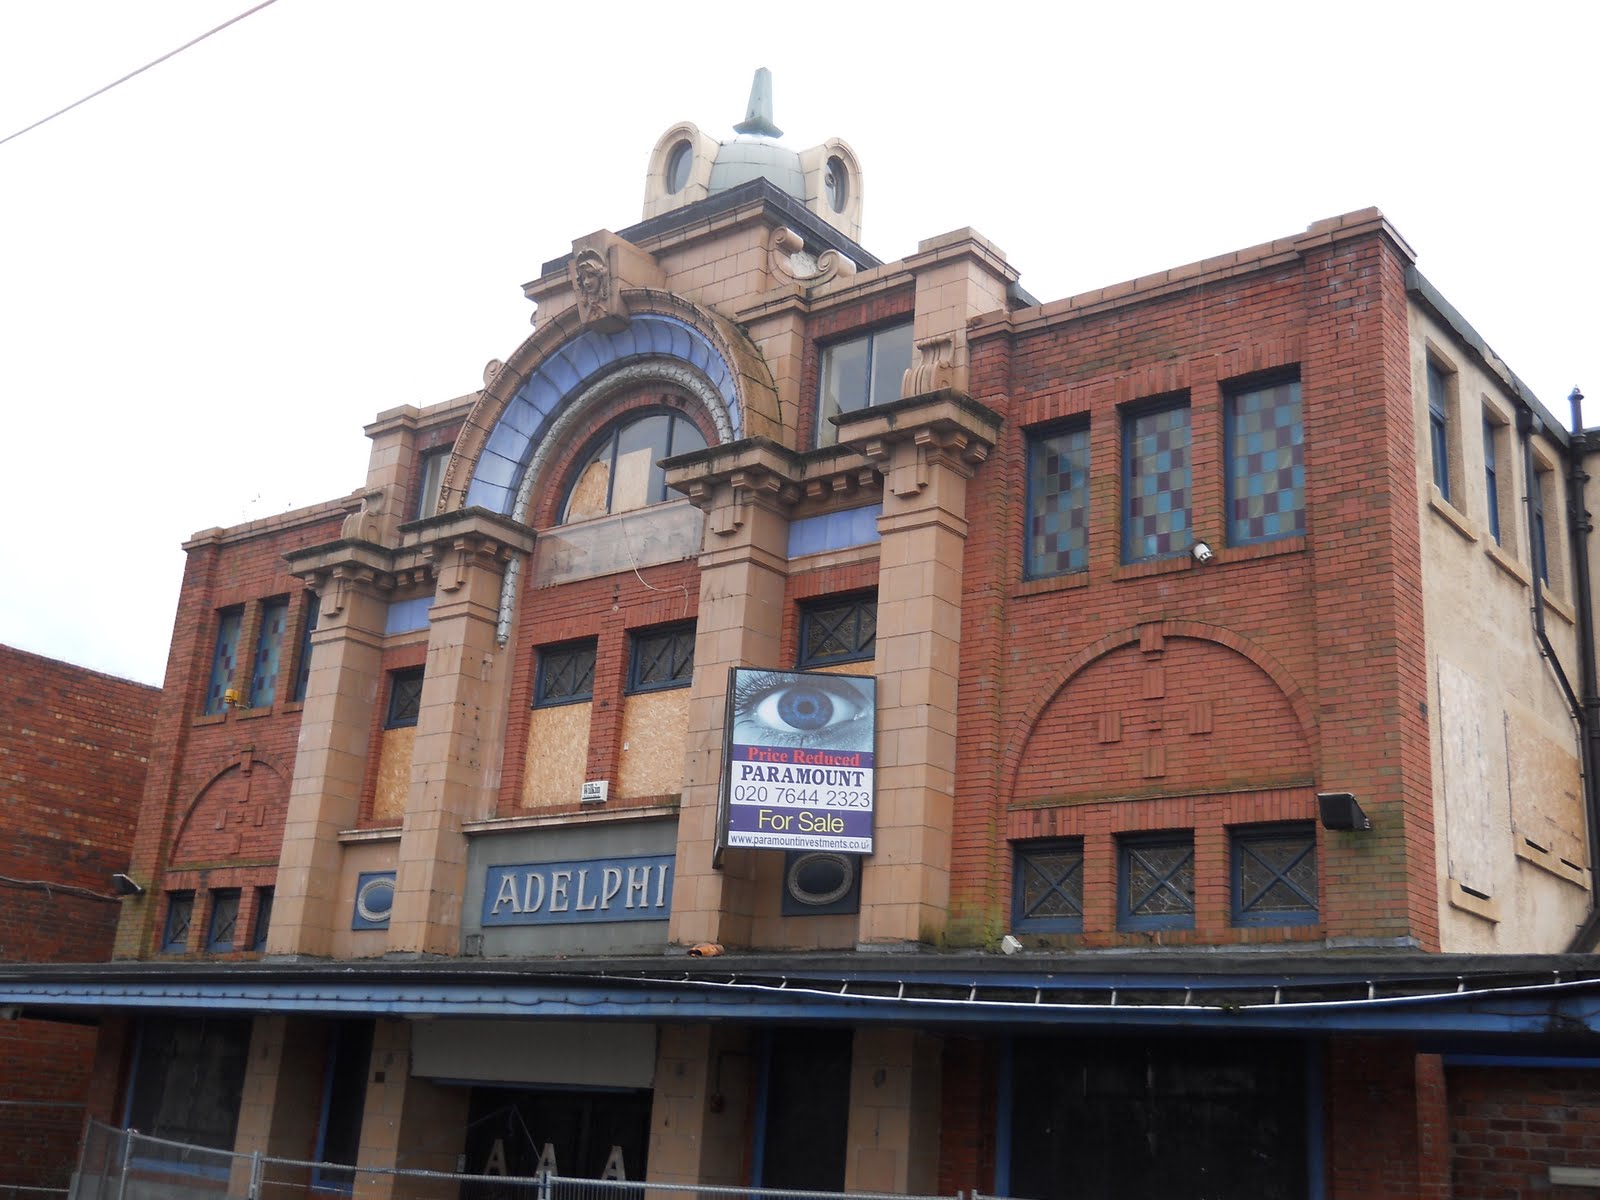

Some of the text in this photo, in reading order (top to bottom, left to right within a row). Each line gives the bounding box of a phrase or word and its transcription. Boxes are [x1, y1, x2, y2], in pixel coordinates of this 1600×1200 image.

[747, 747, 861, 767] Price Reduced
[741, 765, 865, 787] PARAMOUNT
[734, 785, 870, 808] 020 7644 2323
[758, 809, 844, 833] For Sale
[730, 834, 870, 850] www.paramountinvestments.cou
[491, 865, 668, 914] ADELPHI
